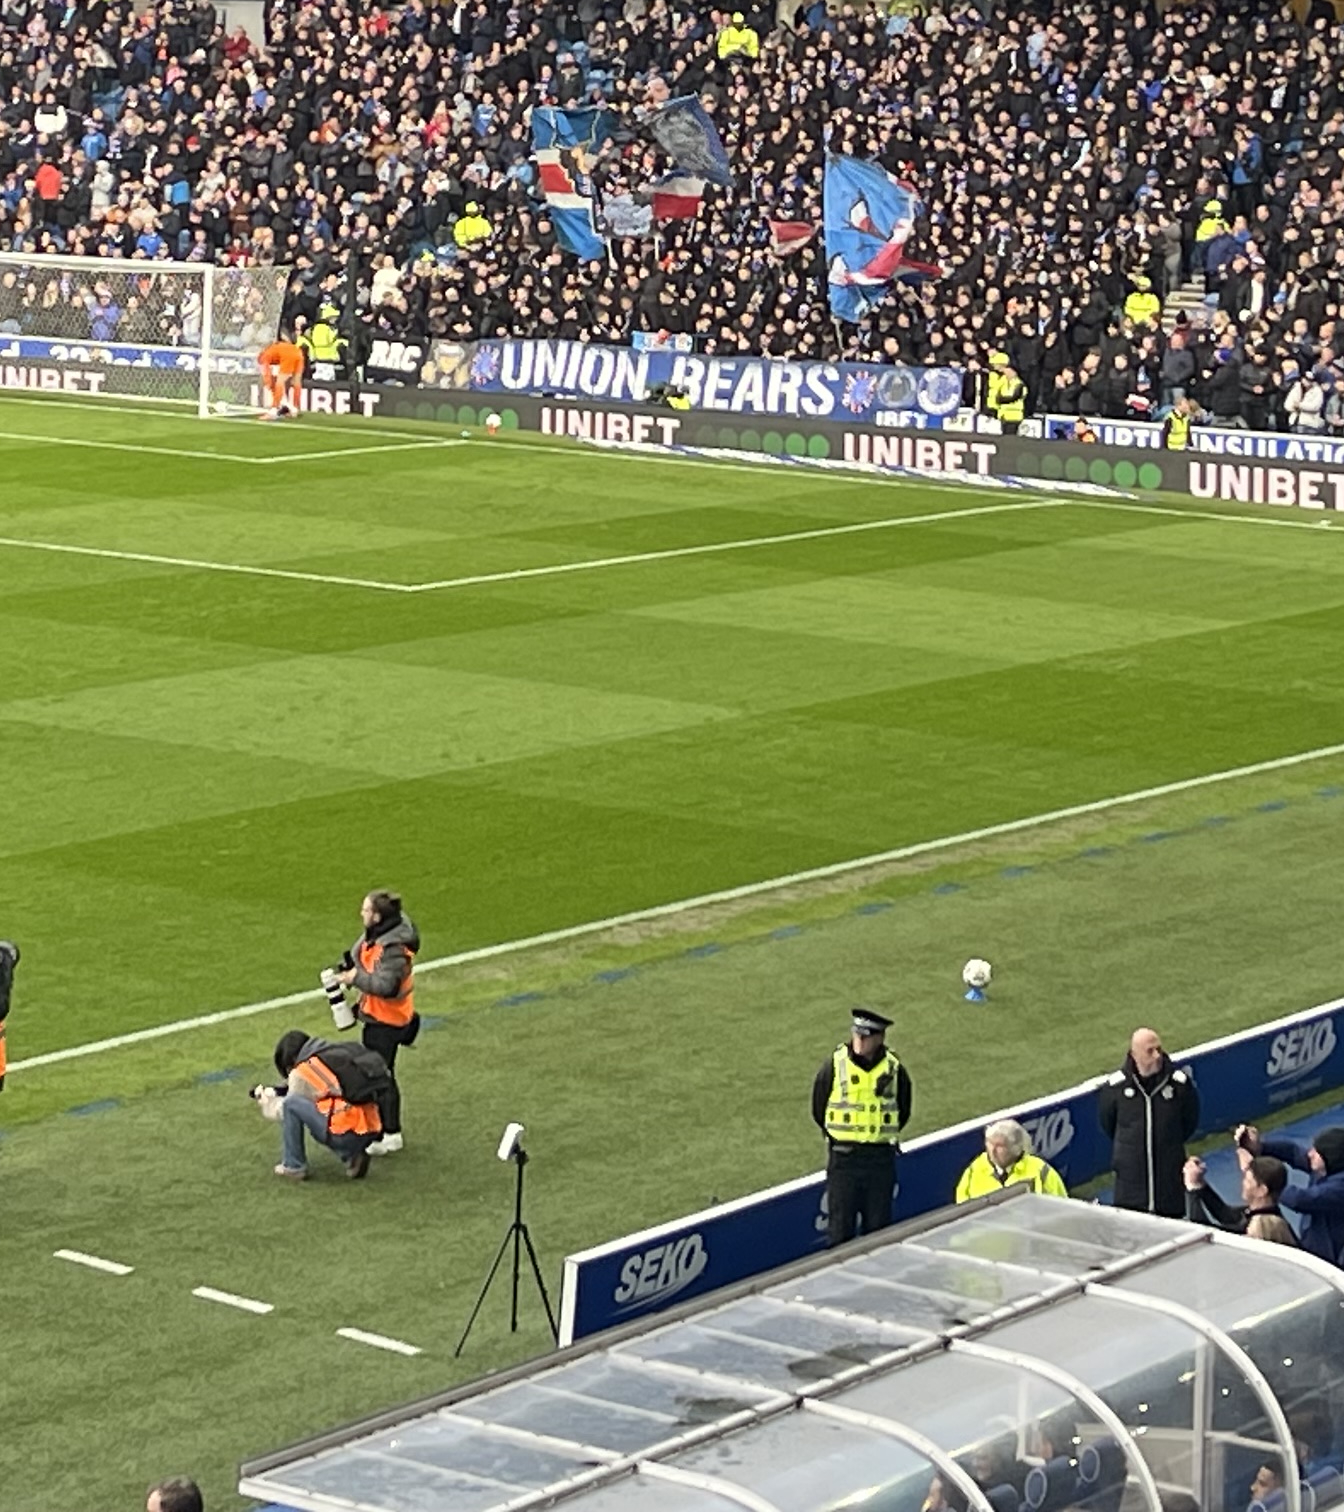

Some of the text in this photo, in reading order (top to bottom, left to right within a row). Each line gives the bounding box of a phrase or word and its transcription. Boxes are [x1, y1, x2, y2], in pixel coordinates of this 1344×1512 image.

[501, 338, 840, 417] UNION BEARS
[540, 406, 681, 446] UNIBET
[843, 432, 997, 476] UNIBET
[1266, 1017, 1338, 1077] SEKO
[614, 1233, 709, 1303] SEKO
